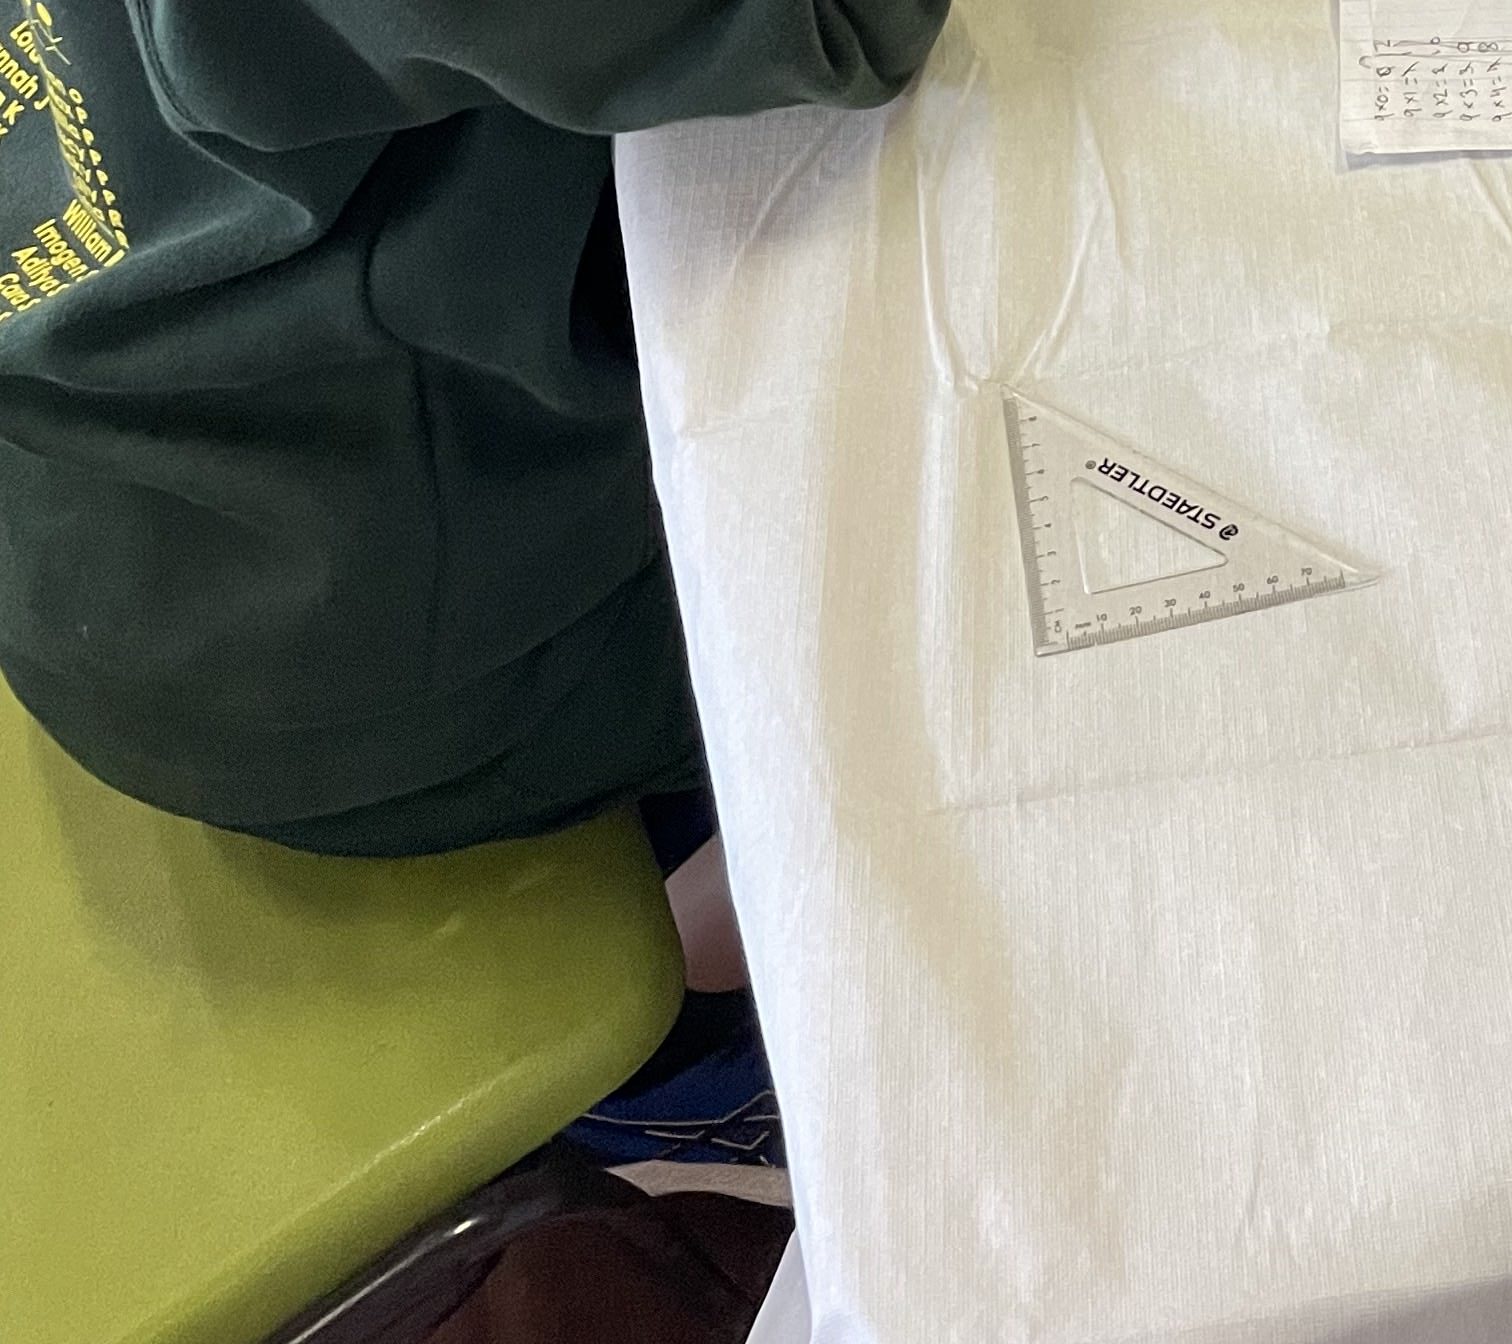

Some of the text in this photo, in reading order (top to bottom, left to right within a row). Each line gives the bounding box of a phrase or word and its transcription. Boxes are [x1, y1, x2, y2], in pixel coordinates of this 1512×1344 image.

[33, 218, 89, 278] Imogen
[1098, 457, 1221, 530] STAEDTLER
[1129, 605, 1142, 615] 20
[1164, 598, 1177, 608] 30
[1232, 583, 1245, 592] 50
[1266, 575, 1279, 584] 60
[1301, 567, 1312, 576] 70
